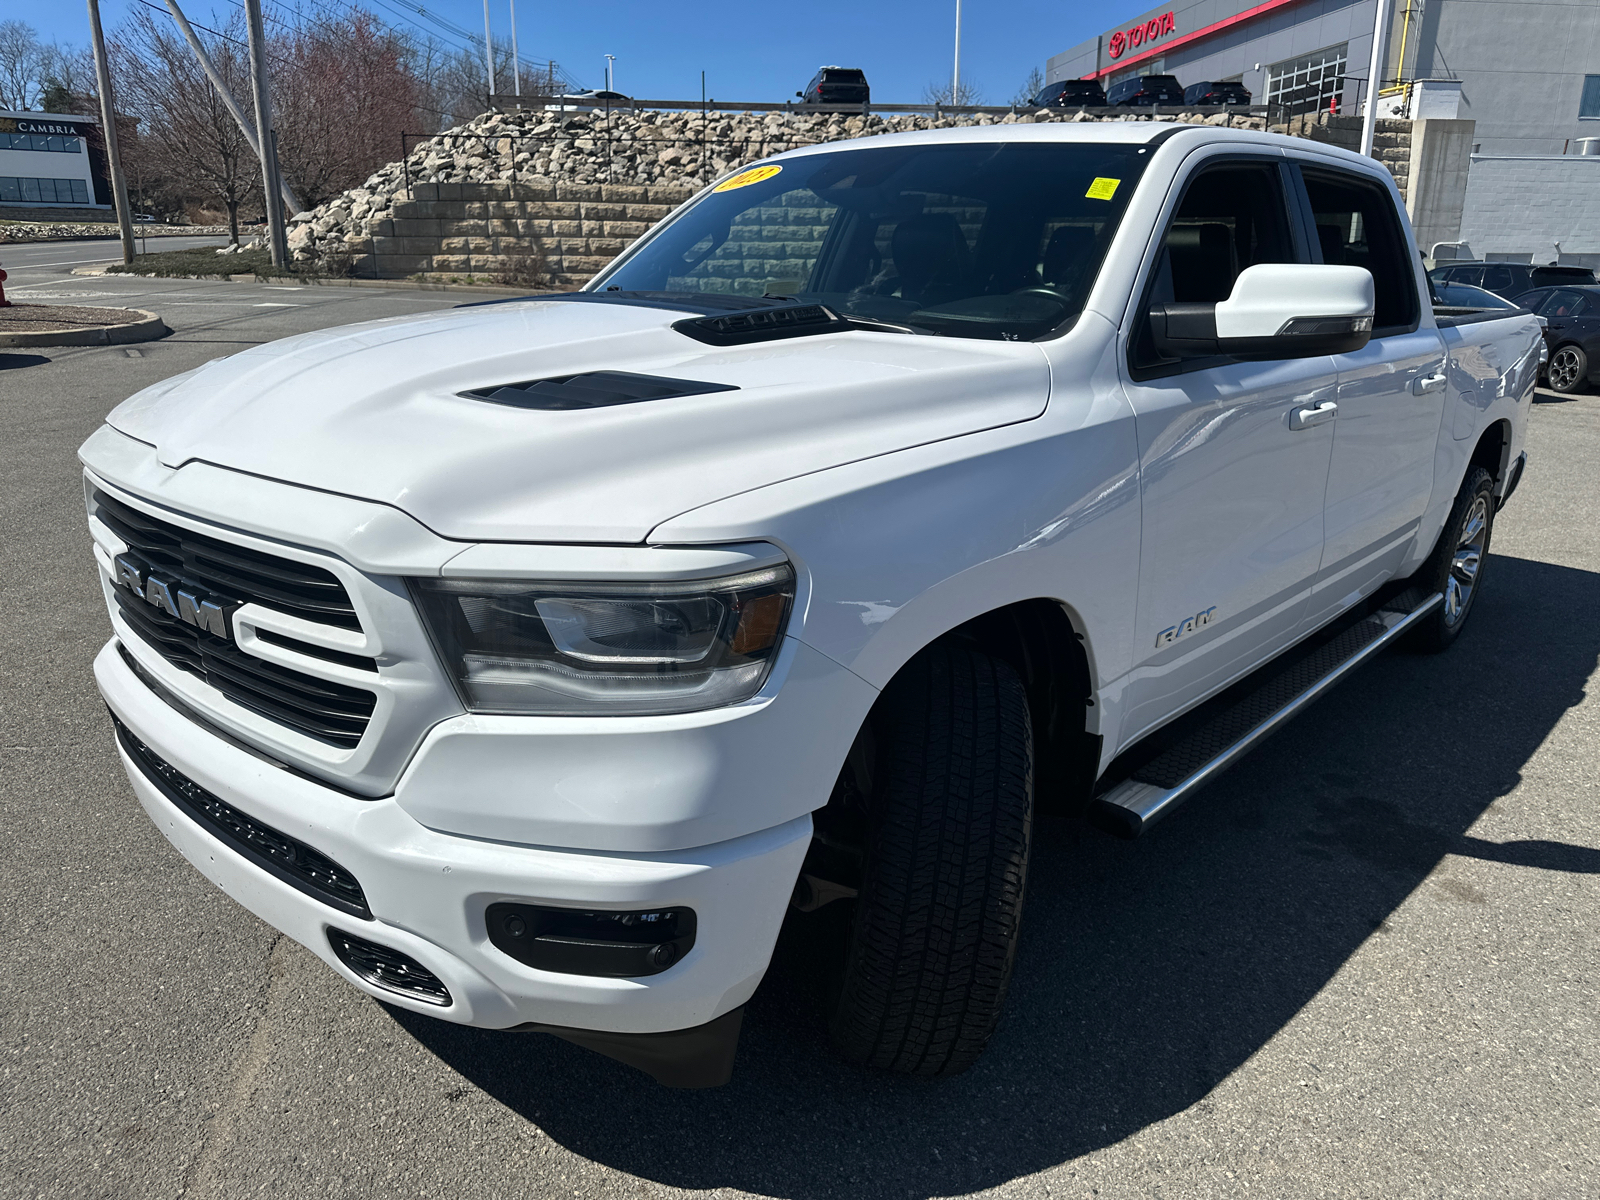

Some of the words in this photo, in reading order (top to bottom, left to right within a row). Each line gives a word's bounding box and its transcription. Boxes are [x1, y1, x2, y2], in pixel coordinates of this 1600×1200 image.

[1126, 11, 1175, 50] TOYOTA
[114, 554, 234, 640] RAM
[1155, 606, 1217, 648] RAM
